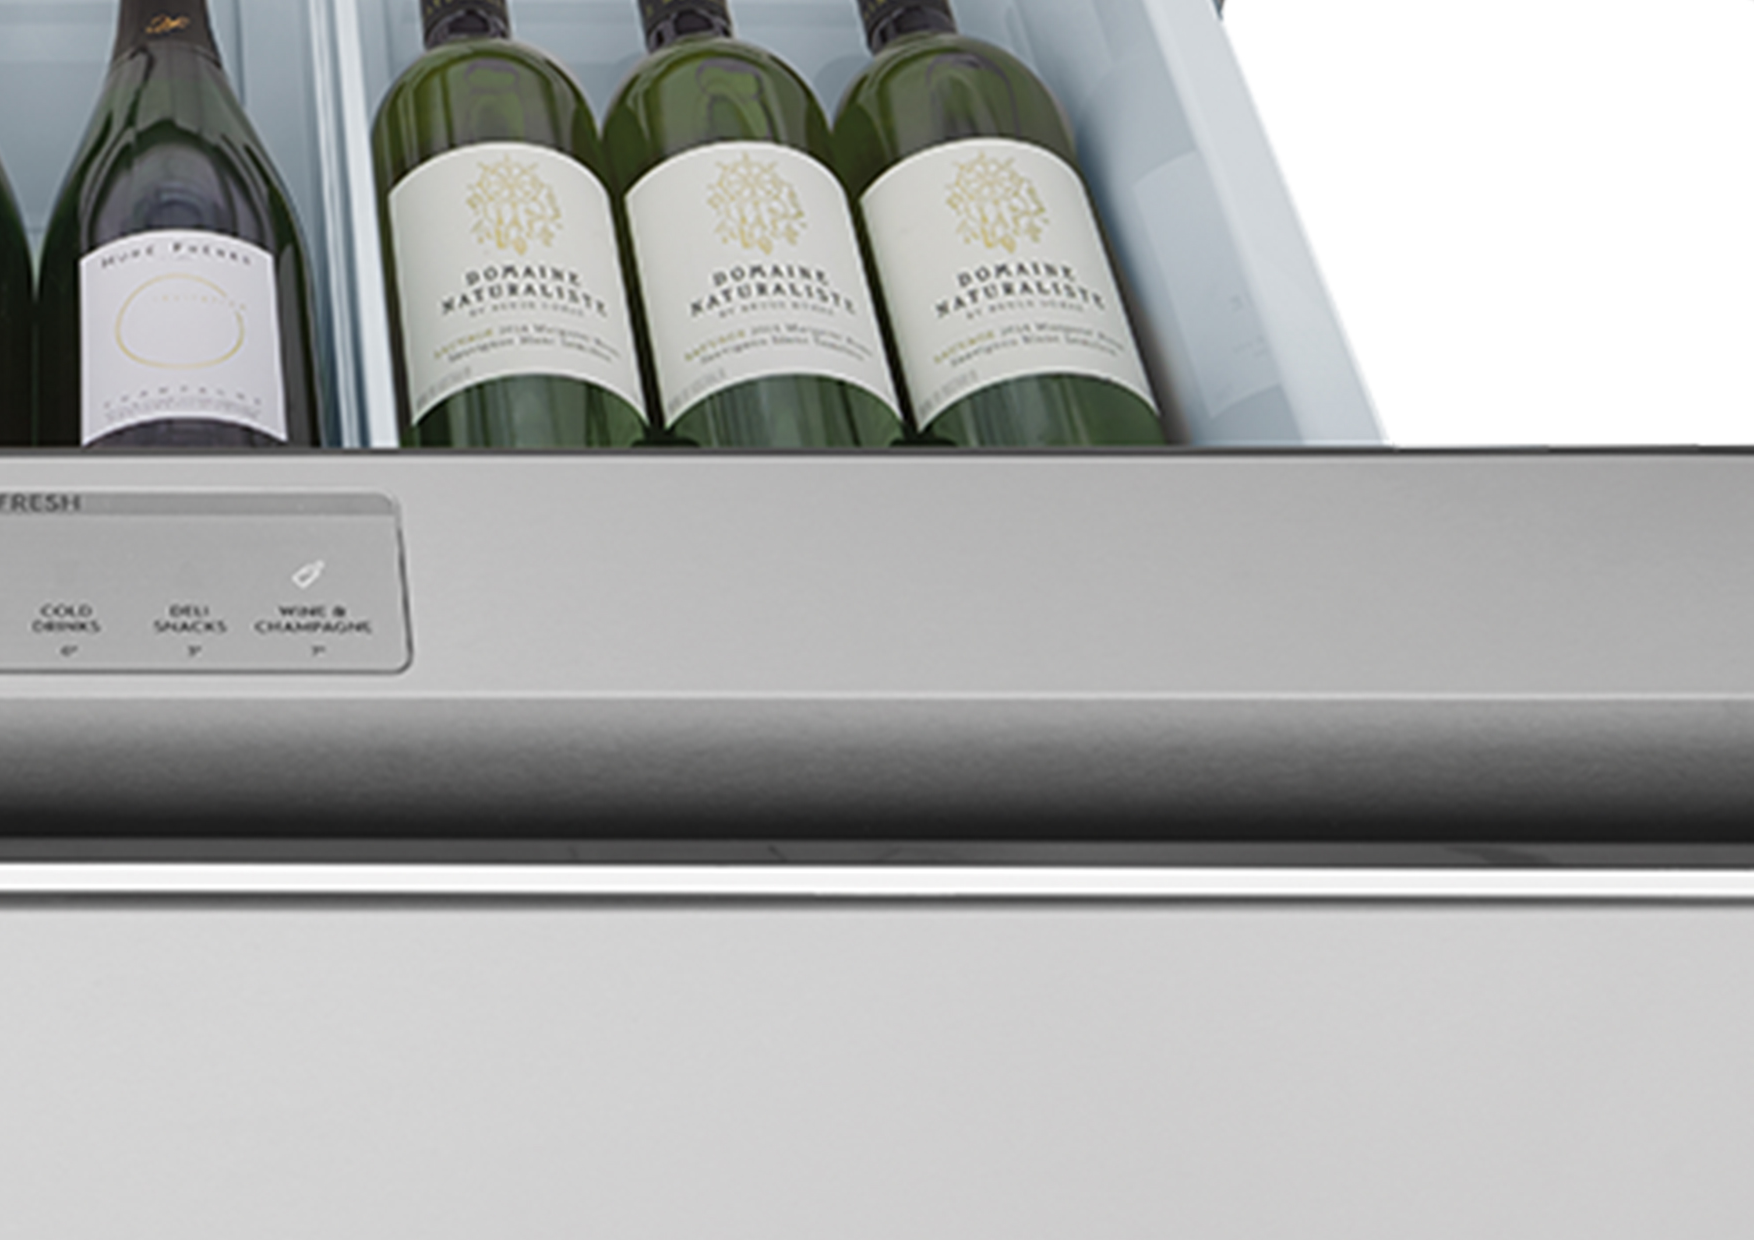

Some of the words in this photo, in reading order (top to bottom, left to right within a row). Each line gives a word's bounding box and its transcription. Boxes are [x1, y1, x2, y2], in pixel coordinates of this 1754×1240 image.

[464, 264, 583, 287] DOMAINE
[712, 264, 830, 287] DOMAINE
[956, 261, 1077, 288] DOMAINE
[441, 282, 609, 317] NATURALISTE
[689, 282, 856, 317] NATURALISTE
[935, 281, 1106, 318] NATURALISTE
[39, 603, 93, 618] COLD
[168, 604, 210, 618] DELI
[278, 605, 326, 618] WINE
[31, 619, 101, 634] DRINKS
[153, 619, 228, 634] SNACKS
[254, 619, 374, 635] CHAMPAGNE
